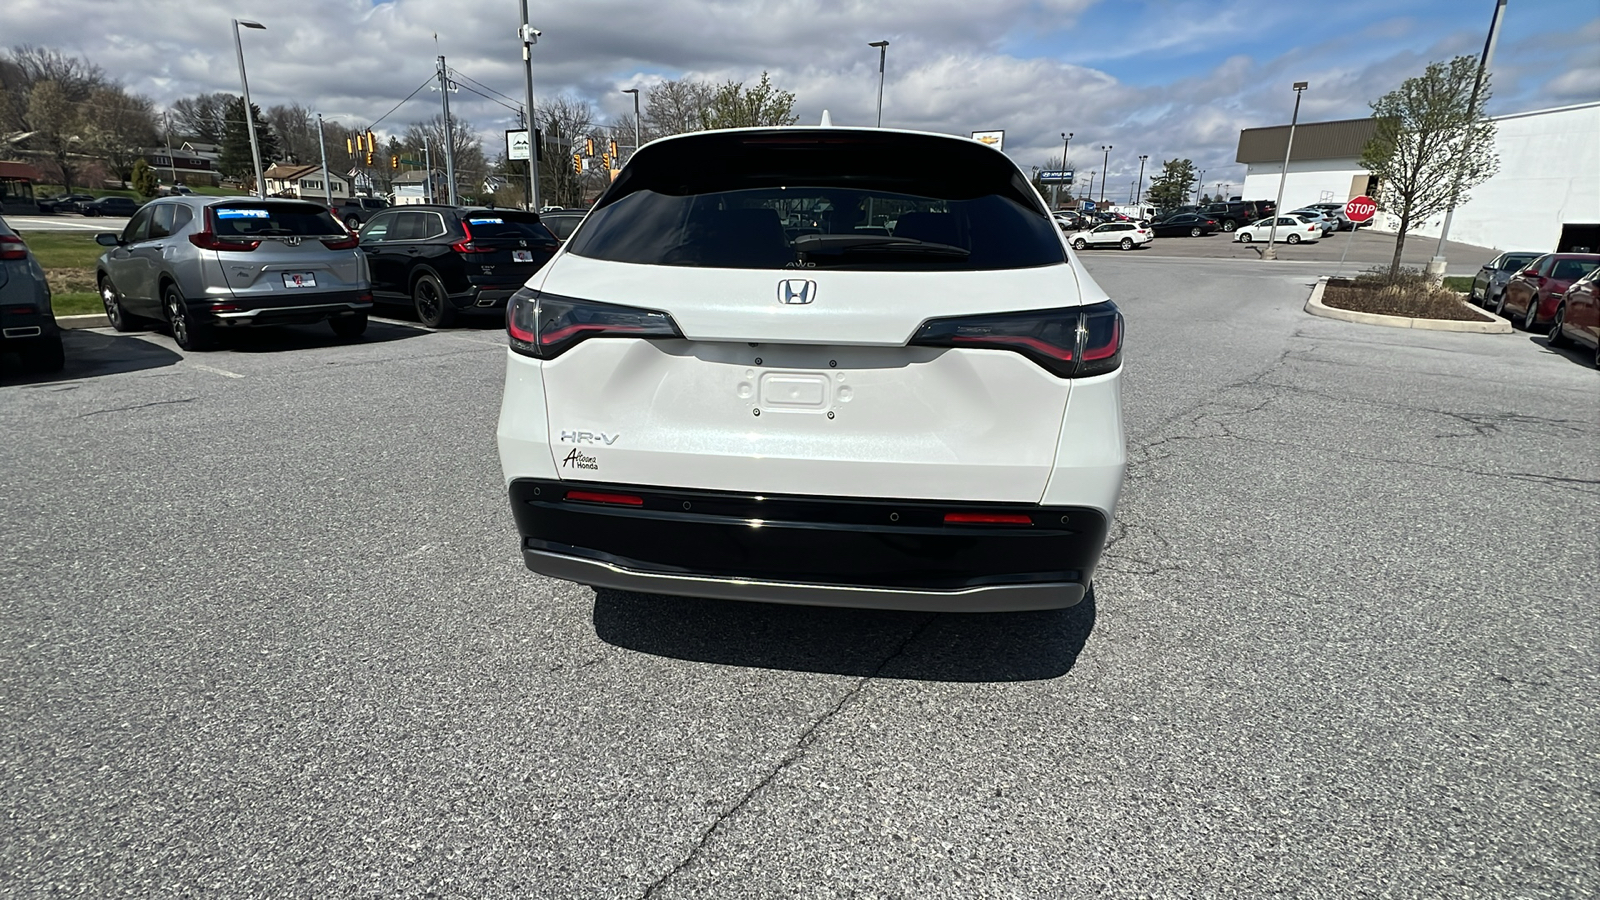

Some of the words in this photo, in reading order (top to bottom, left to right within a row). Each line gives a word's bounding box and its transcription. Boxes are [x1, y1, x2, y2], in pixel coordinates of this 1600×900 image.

[1347, 203, 1375, 215] STOP
[561, 431, 620, 445] HR-V
[577, 461, 599, 470] Honda
